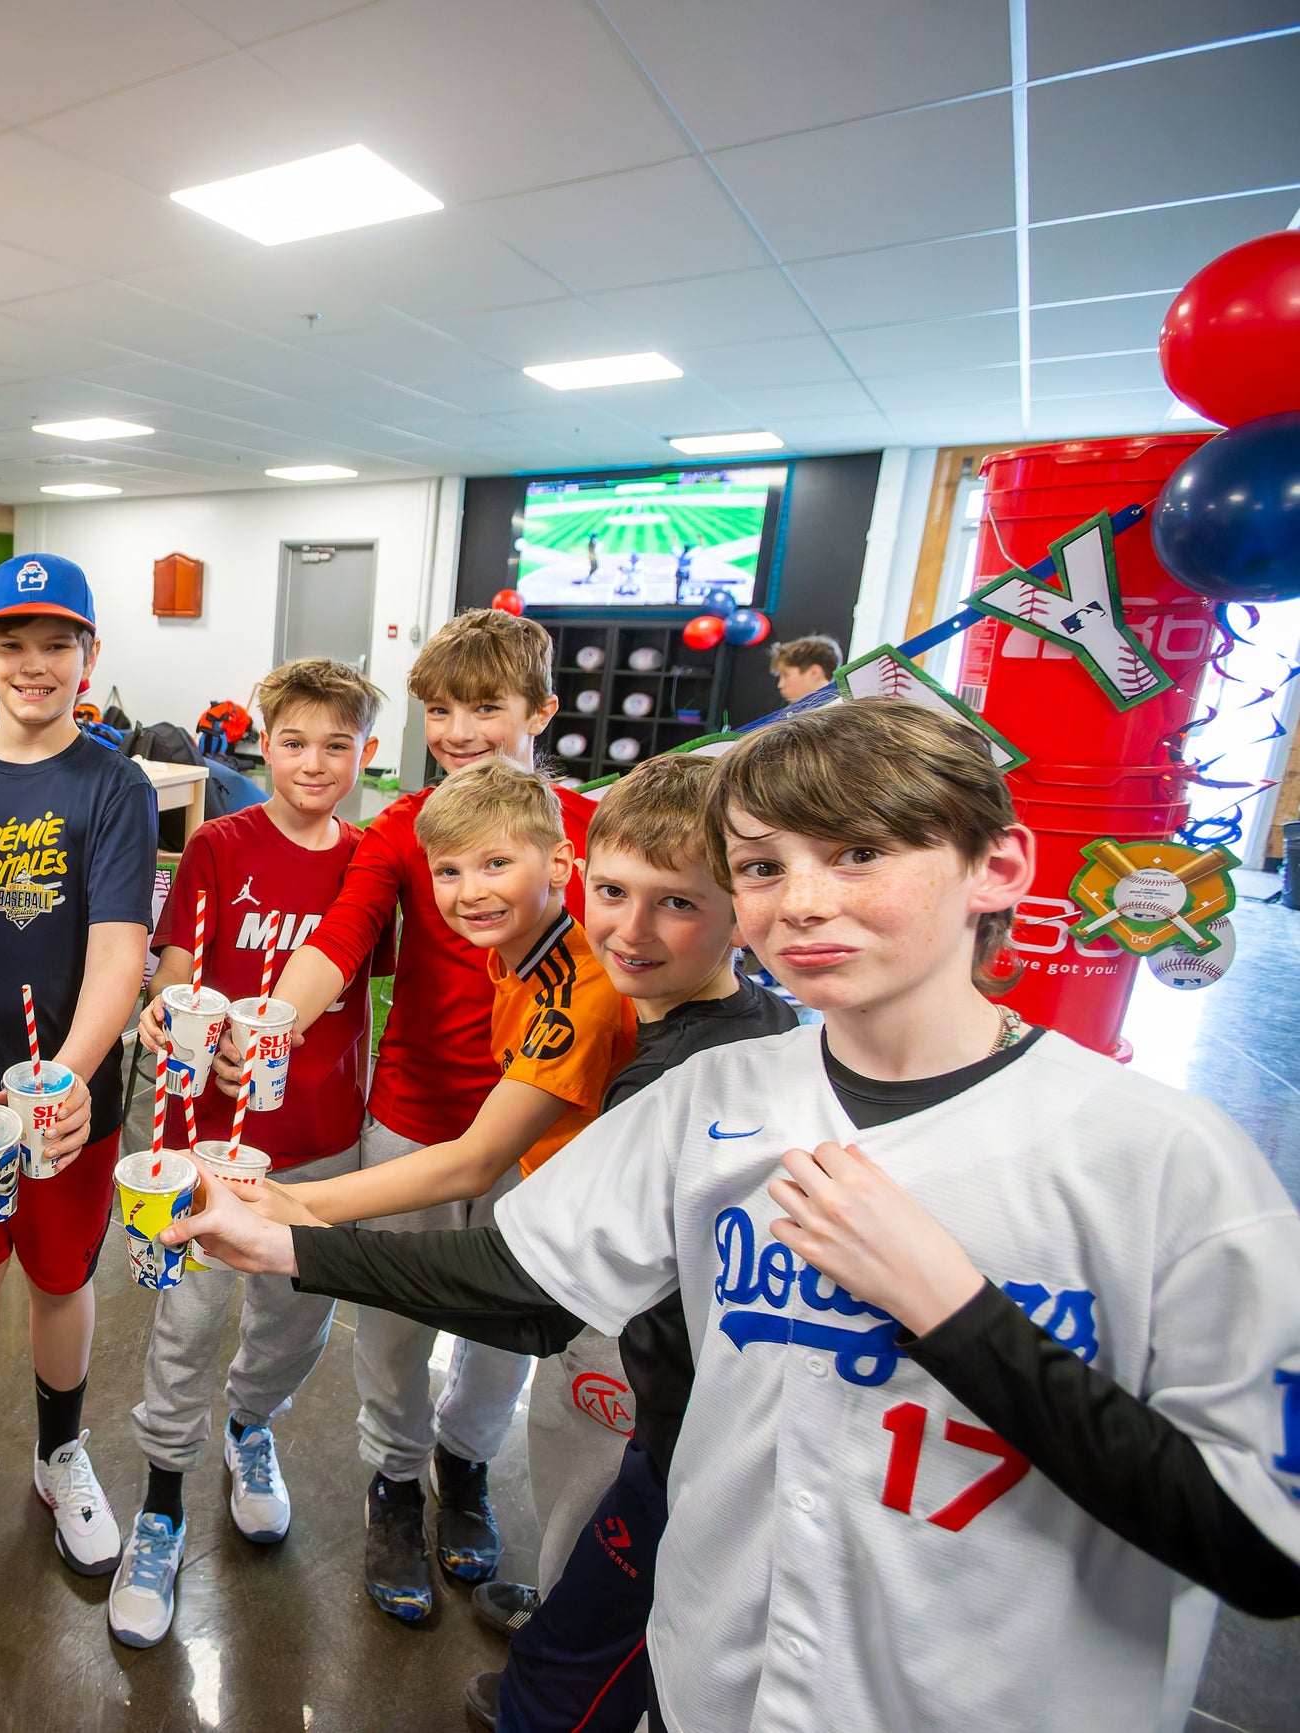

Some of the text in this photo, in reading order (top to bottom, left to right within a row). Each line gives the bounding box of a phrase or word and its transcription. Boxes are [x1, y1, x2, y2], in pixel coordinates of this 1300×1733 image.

[235, 912, 322, 950] MIA
[1046, 962, 1079, 975] got
[1084, 963, 1118, 977] you!
[881, 1401, 1032, 1533] 17
